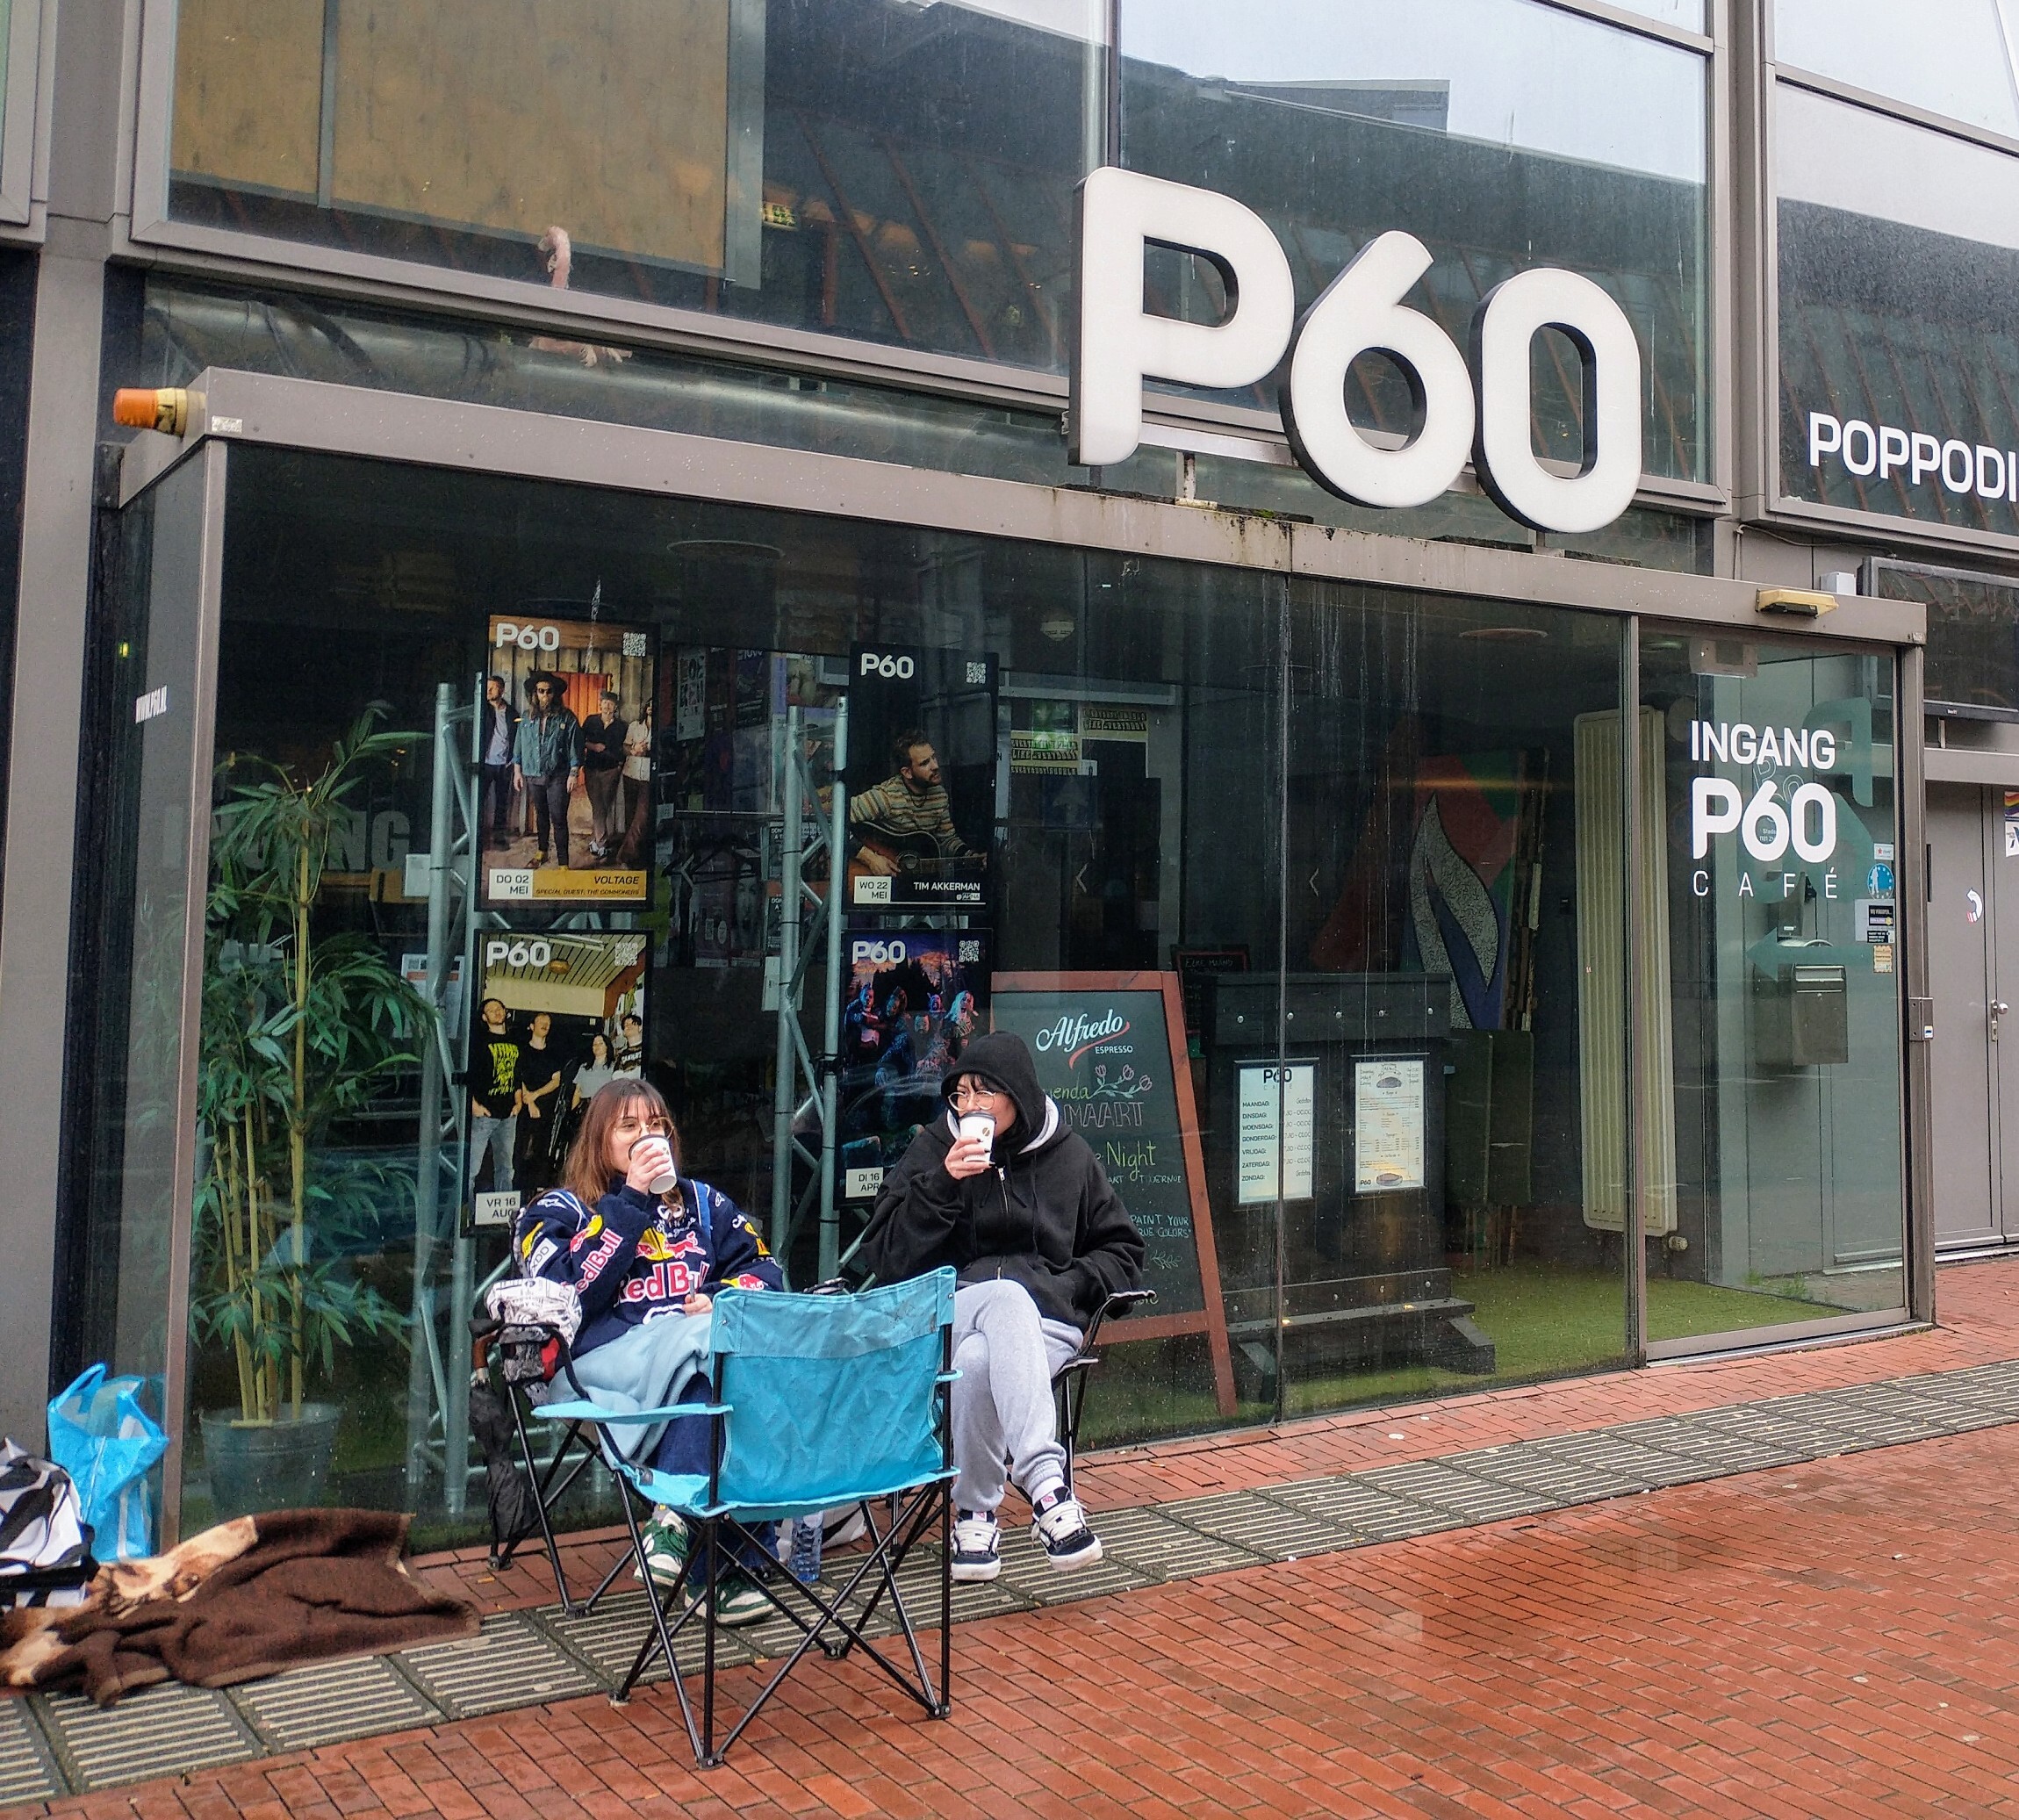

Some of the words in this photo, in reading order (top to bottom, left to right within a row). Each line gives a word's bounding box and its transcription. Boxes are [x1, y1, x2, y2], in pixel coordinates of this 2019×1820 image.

[1069, 166, 1642, 533] P60
[1809, 411, 2017, 502] POPPODI
[496, 622, 560, 651] P60
[861, 653, 914, 679] P60
[1692, 719, 1836, 770] INGANG
[1692, 777, 1836, 863] P60
[496, 874, 513, 884] DO
[515, 874, 528, 884] 02
[509, 885, 528, 895] MEI
[593, 876, 639, 885] VOLTAGE
[913, 882, 929, 891] TIM
[931, 881, 981, 891] AKKERMAN
[486, 941, 550, 968] P60
[851, 940, 906, 964] P60
[1036, 1009, 1124, 1051] Alfredo
[1095, 1045, 1133, 1054] ESPRESSO
[1063, 1102, 1144, 1128] MAART
[1106, 1140, 1158, 1182] Night
[859, 1173, 867, 1182] DI
[860, 1183, 880, 1191] APR
[486, 1198, 501, 1207] VR
[505, 1198, 516, 1206] 16
[1168, 1215, 1189, 1227] YOUR
[574, 1227, 623, 1295] edBull
